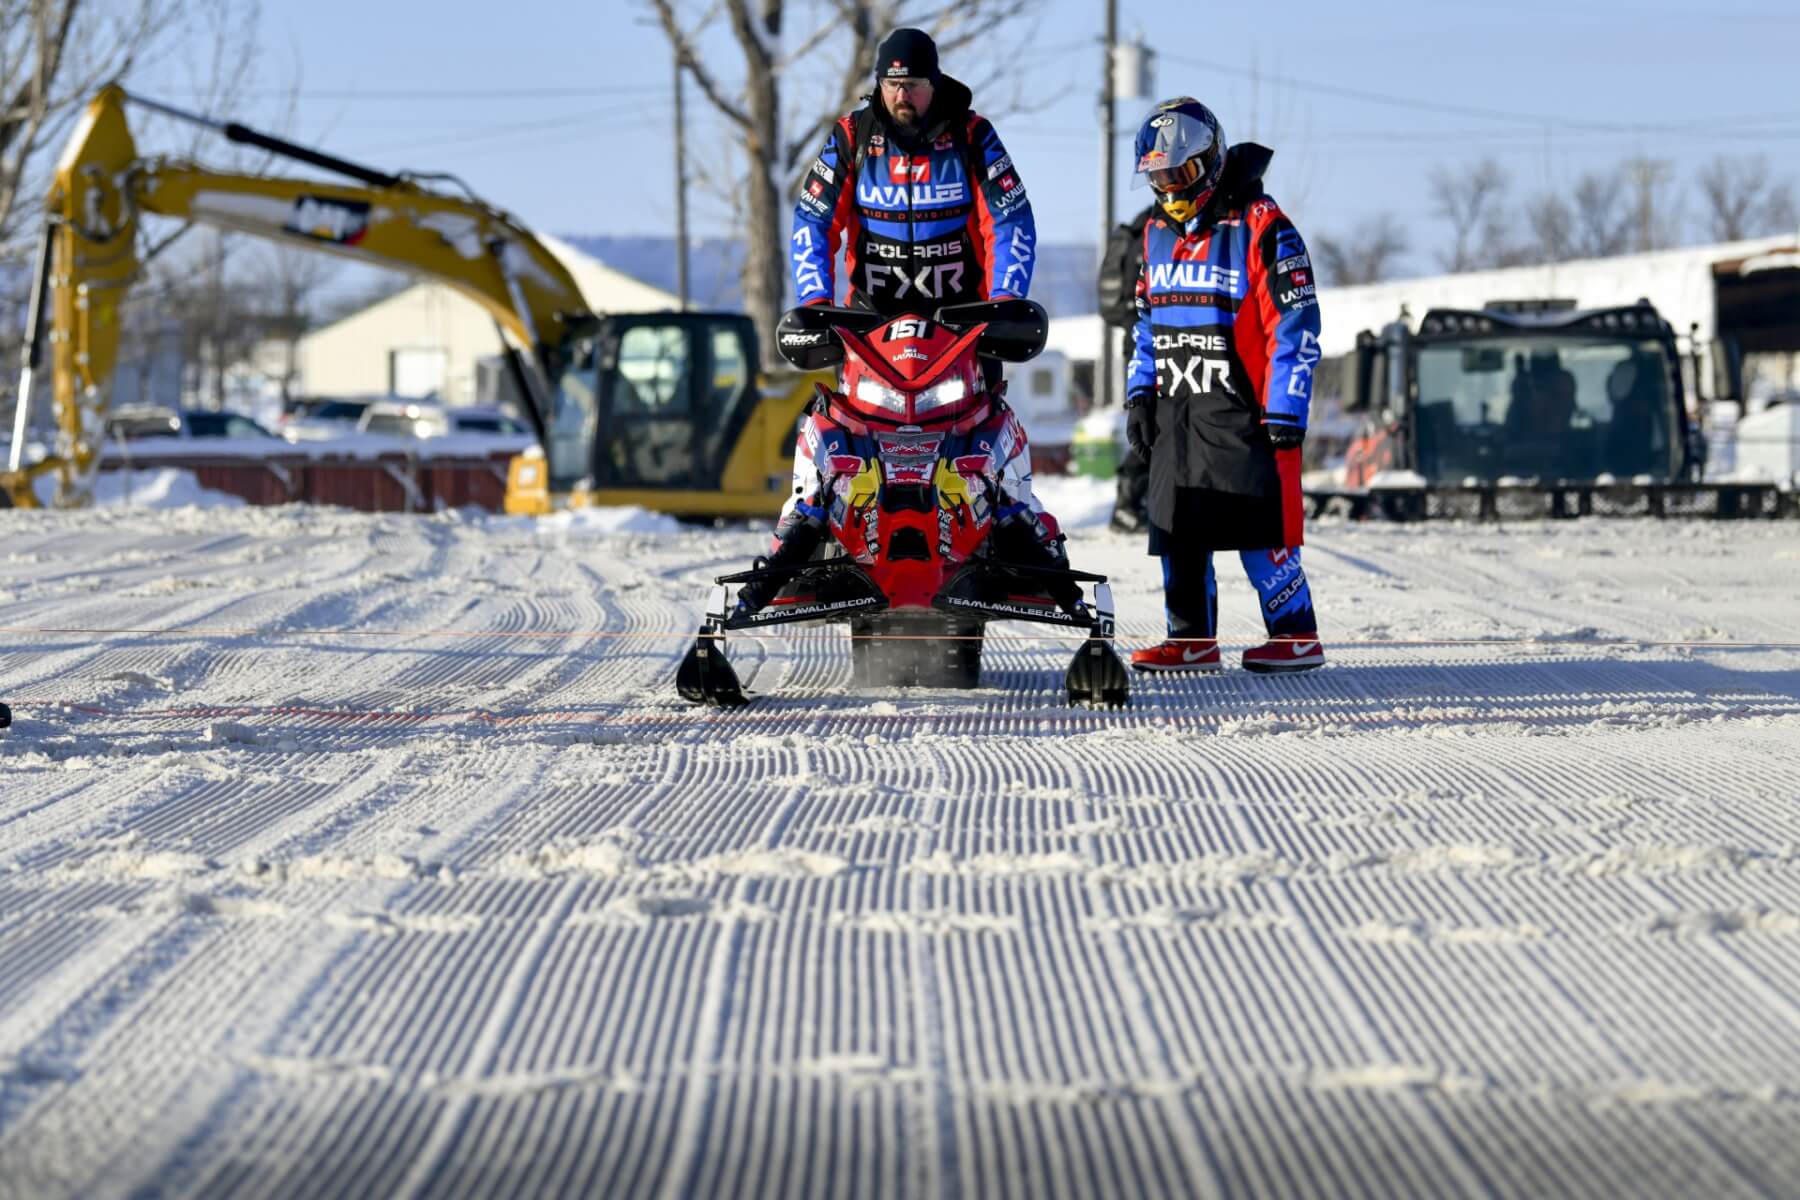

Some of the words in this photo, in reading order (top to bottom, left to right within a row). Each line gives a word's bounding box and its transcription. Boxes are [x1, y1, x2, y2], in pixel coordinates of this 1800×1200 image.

[860, 182, 963, 207] LAVALLEE
[866, 240, 962, 258] POLARIS
[864, 262, 965, 299] FXR
[889, 319, 928, 341] 151
[1268, 574, 1306, 612] POLAR
[750, 596, 877, 622] TEAMLAVALLEE.COM
[948, 596, 1073, 621] TEAMLAVALLEE.COM
